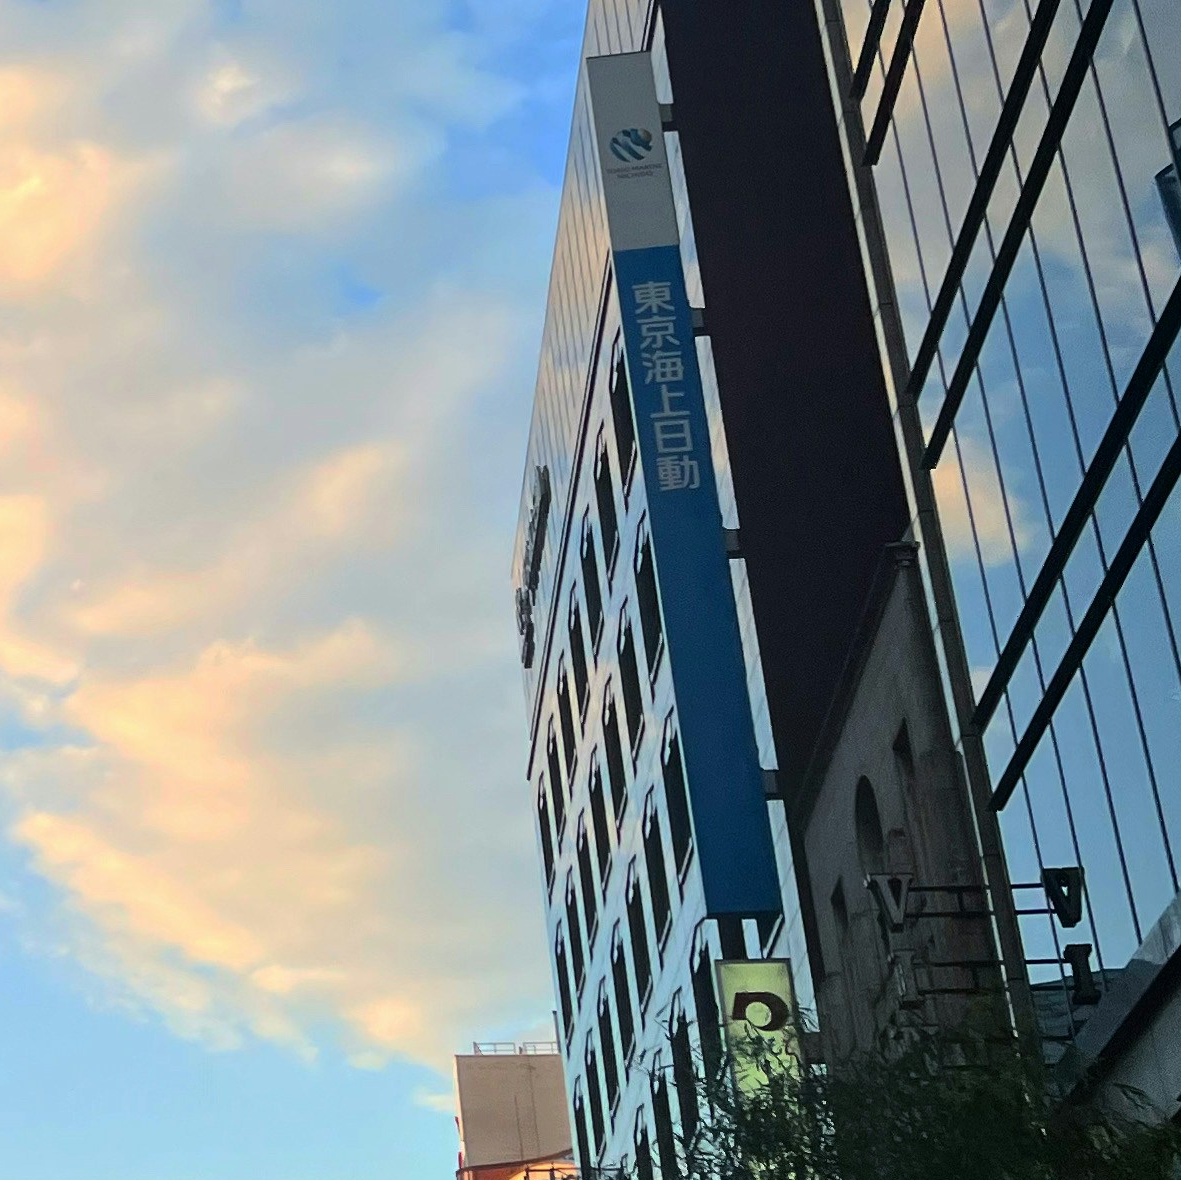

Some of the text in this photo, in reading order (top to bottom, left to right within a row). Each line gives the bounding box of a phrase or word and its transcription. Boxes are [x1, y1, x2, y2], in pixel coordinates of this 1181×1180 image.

[631, 281, 700, 491] 東京海上日動
